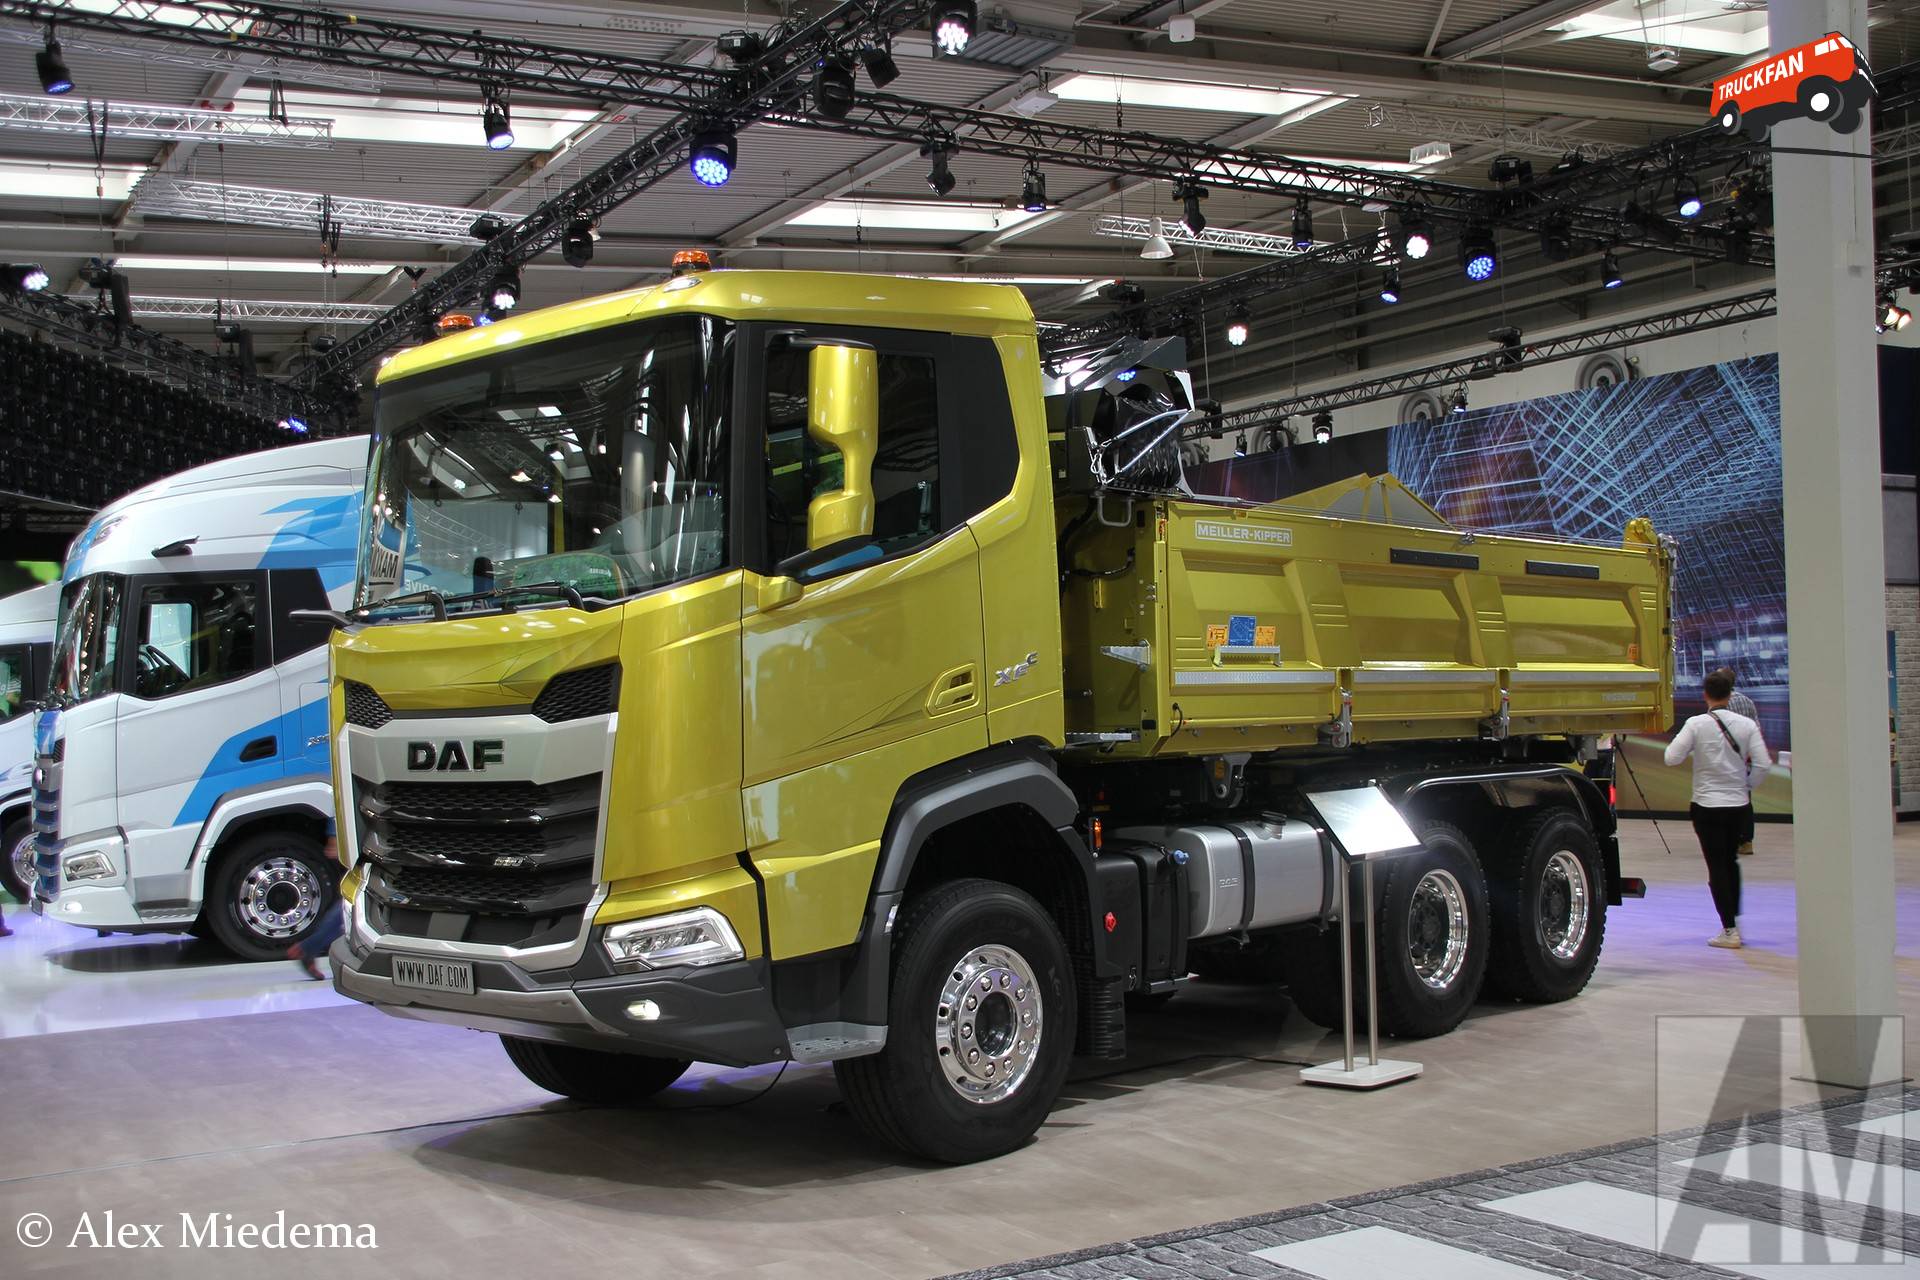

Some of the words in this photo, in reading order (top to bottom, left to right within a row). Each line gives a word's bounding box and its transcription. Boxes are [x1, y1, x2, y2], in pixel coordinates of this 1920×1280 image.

[1197, 523, 1291, 544] MEILLER-KIPPER
[407, 739, 505, 773] DAF
[396, 960, 469, 989] WWW.DAF.COM
